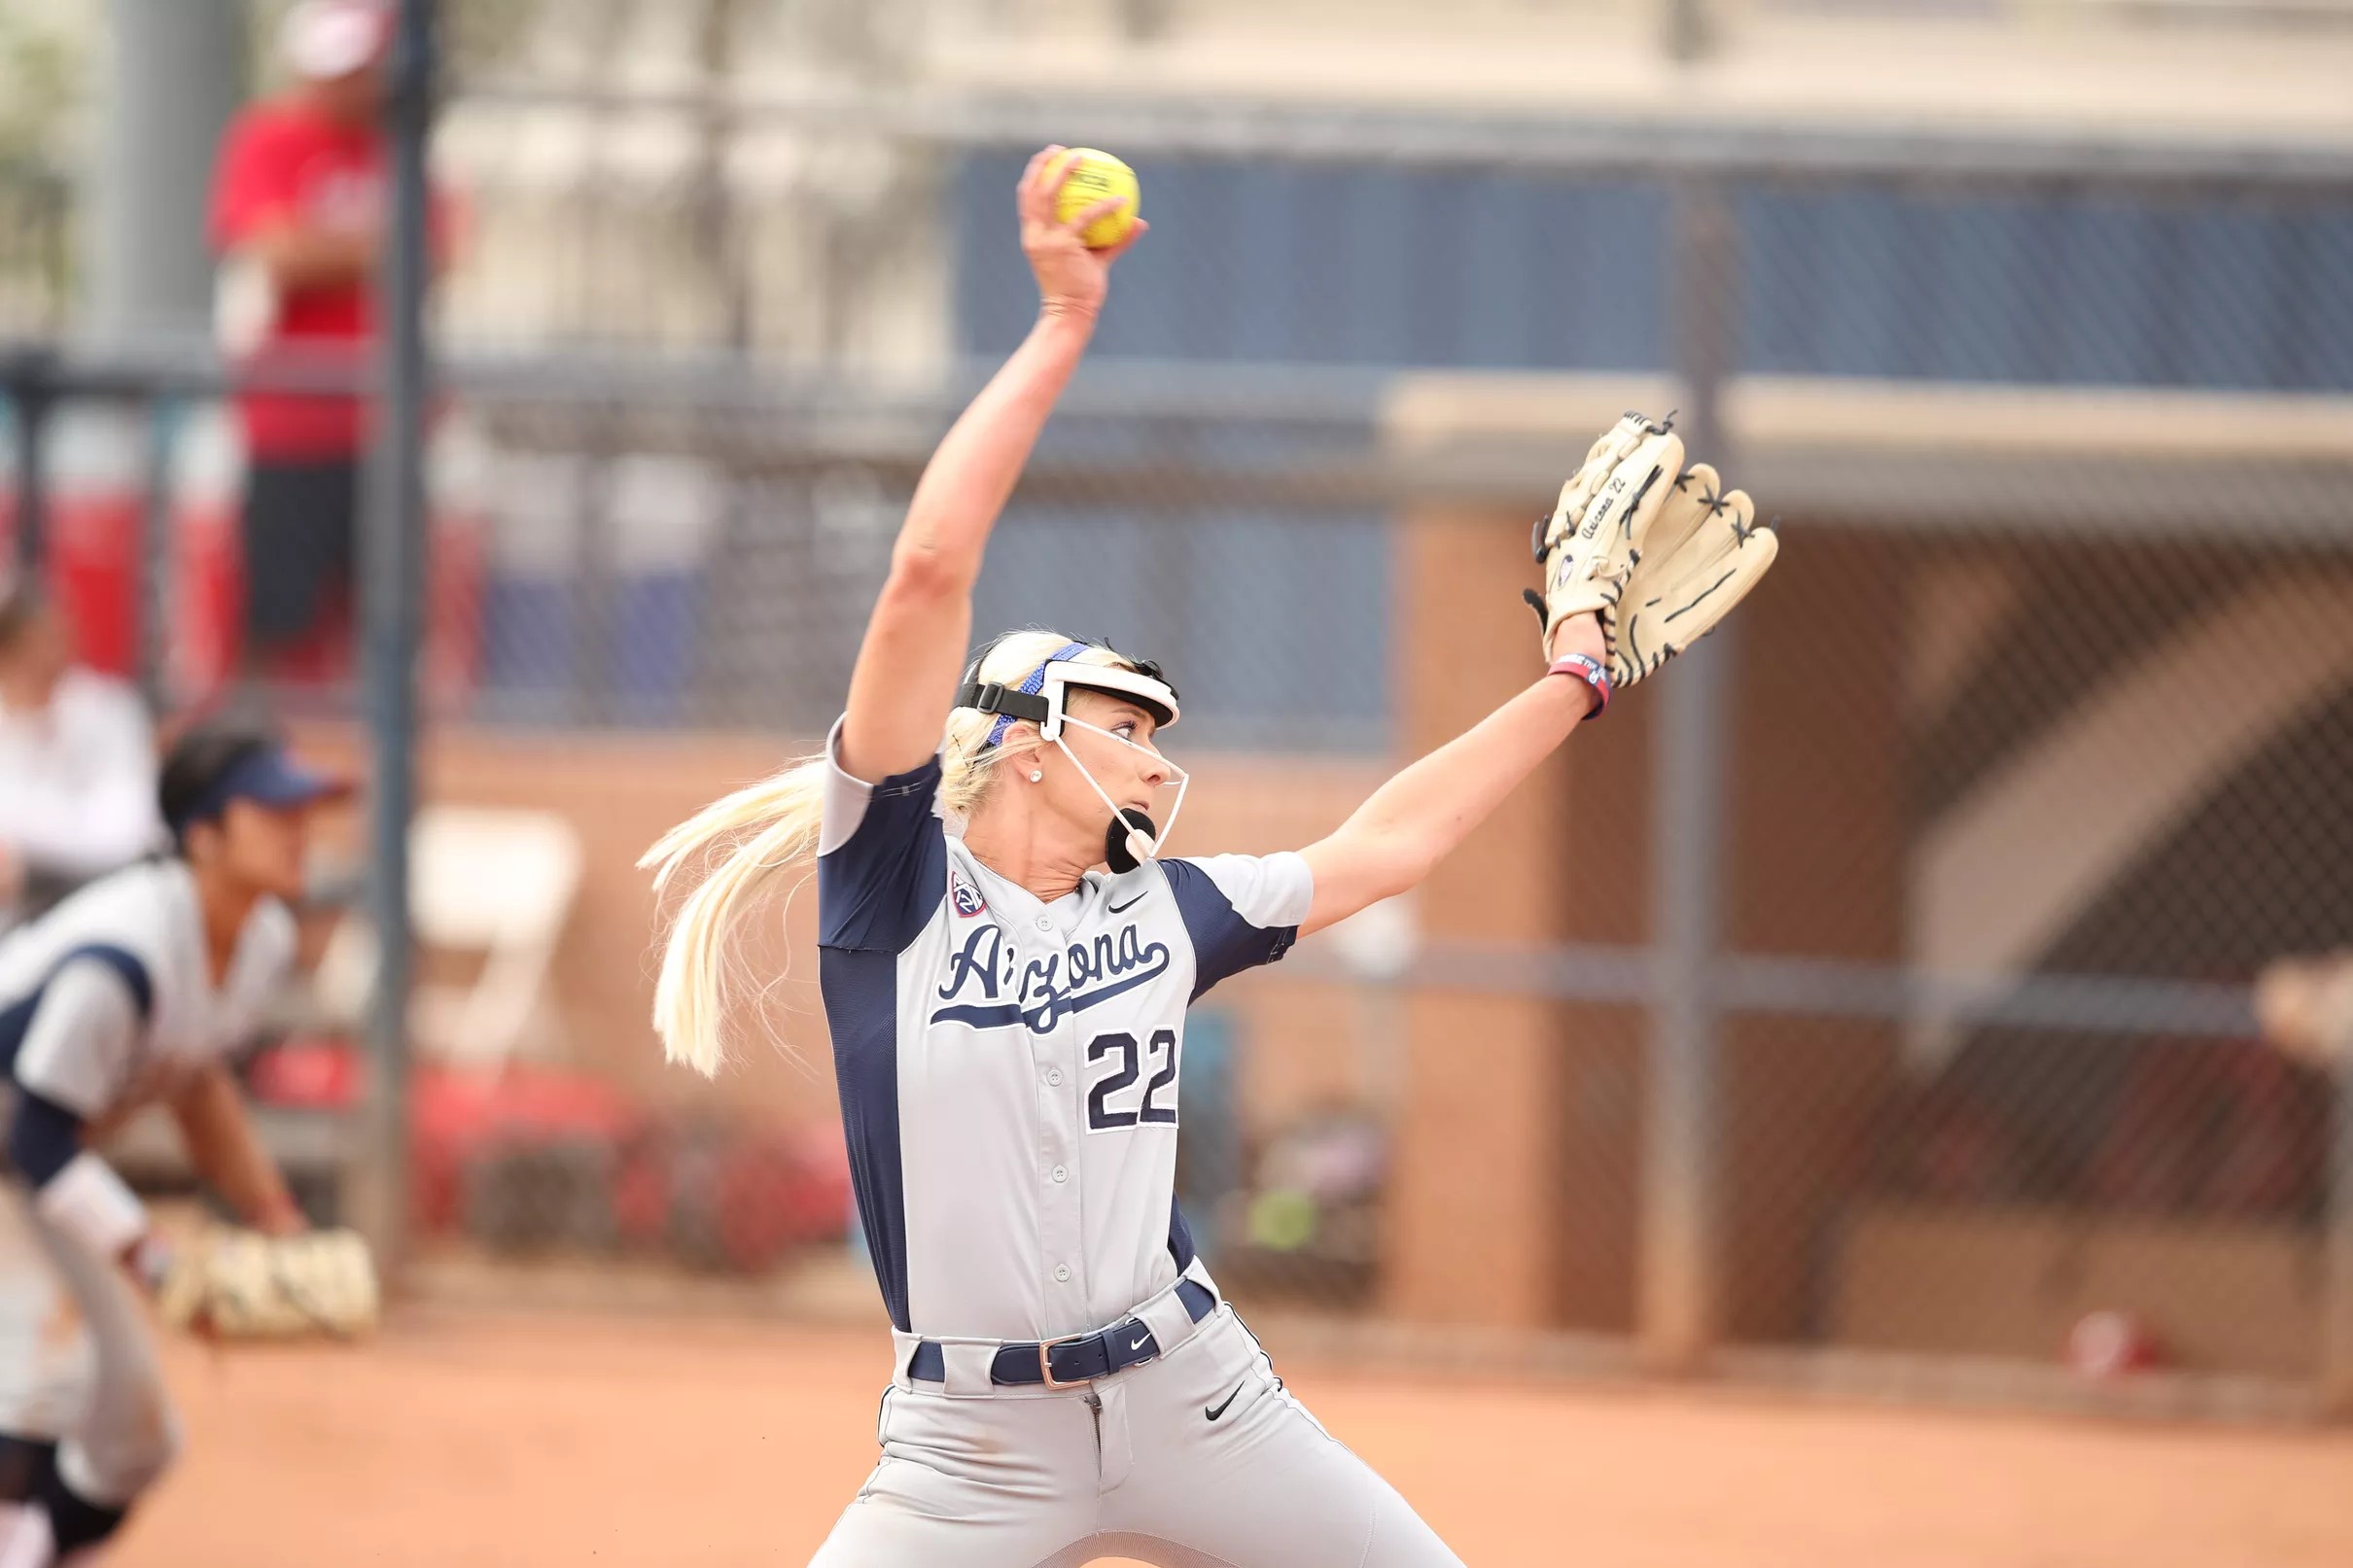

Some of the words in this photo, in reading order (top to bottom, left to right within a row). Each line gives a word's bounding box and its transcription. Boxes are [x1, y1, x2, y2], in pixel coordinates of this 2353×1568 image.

[1608, 476, 1627, 495] 22
[931, 923, 1171, 1035] Azona
[1084, 1027, 1179, 1133] 22
